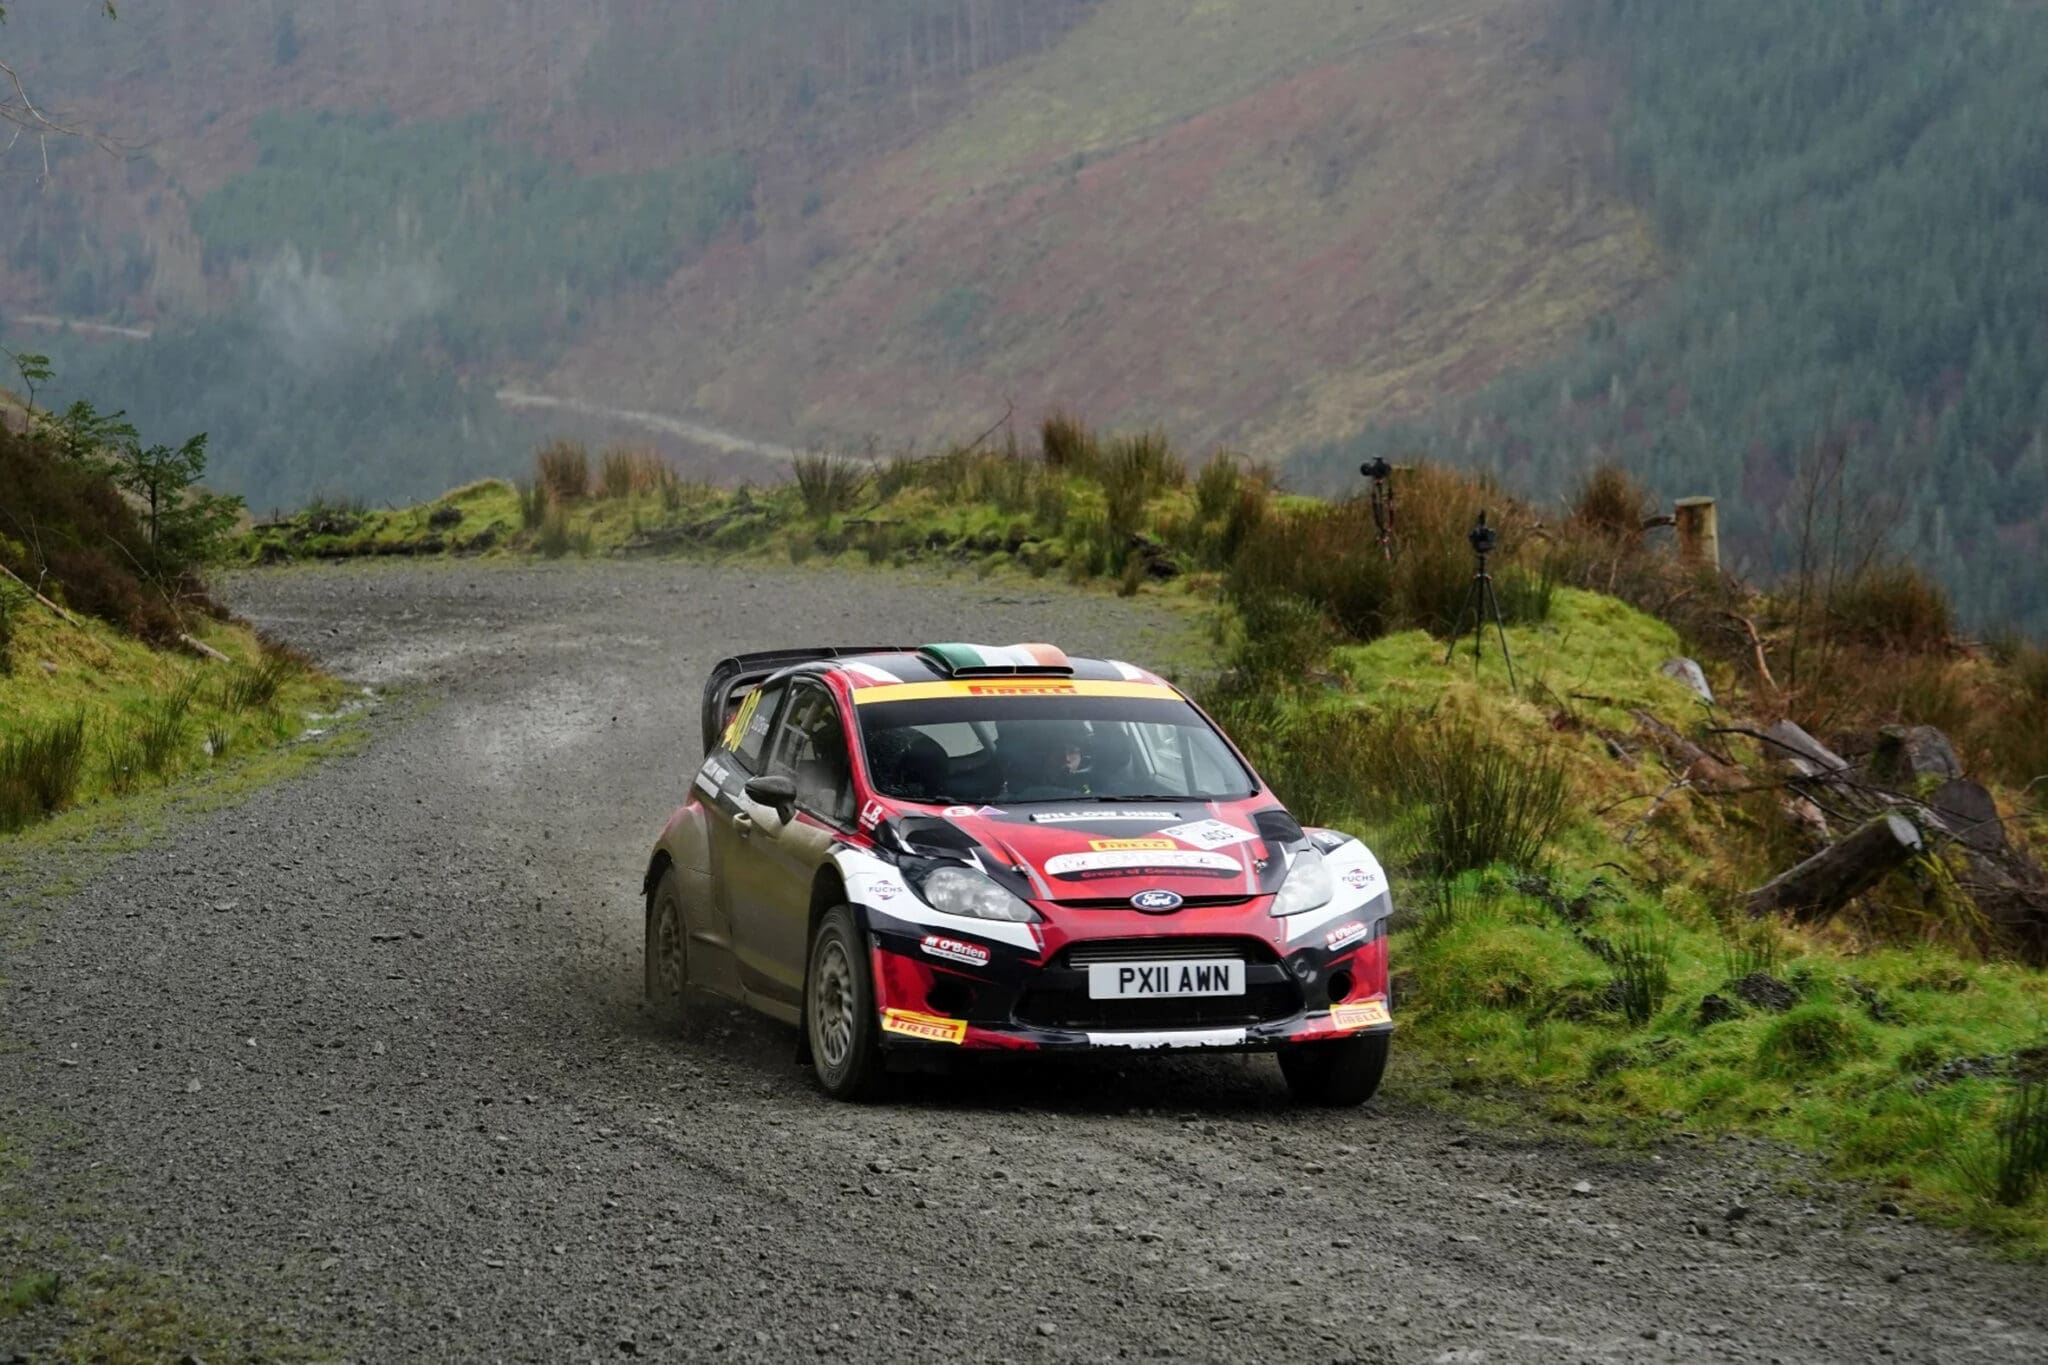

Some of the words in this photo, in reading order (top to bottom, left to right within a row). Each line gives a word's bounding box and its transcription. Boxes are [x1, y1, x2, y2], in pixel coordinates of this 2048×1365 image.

[968, 685, 1078, 695] PIRELLI
[1342, 874, 1376, 882] FUCHS
[925, 936, 939, 947] M
[939, 939, 987, 959] O'Brien
[1118, 966, 1170, 994] PX11
[1178, 965, 1230, 992] AWN
[1335, 1007, 1383, 1025] PIRELLI
[890, 1015, 959, 1039] PIRELLI
